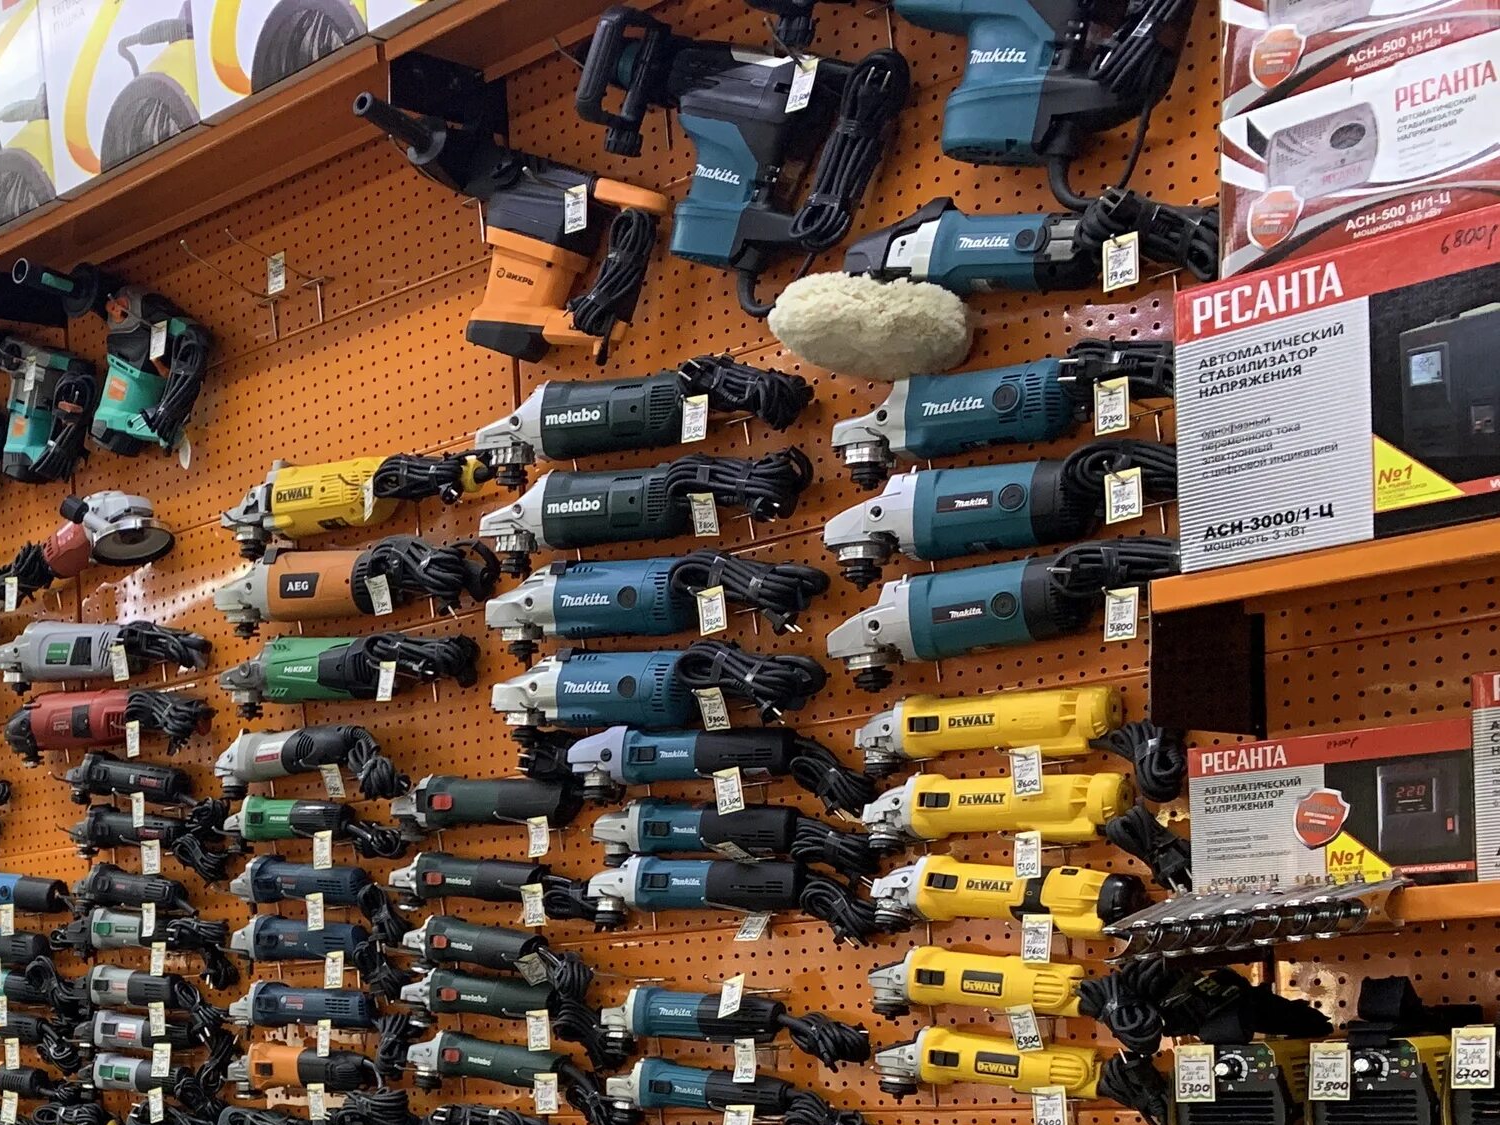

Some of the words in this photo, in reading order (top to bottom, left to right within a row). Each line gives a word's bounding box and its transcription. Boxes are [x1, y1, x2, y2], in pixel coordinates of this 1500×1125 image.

[970, 47, 1027, 65] Makita
[1394, 60, 1498, 113] РЕСАНТА
[694, 163, 741, 187] Makita
[1345, 204, 1406, 232] АСН-500
[959, 236, 1010, 249] Makita
[1192, 261, 1344, 335] РЕСАНТА
[1199, 321, 1345, 370] АВТОМАТИЧЕСКИЙ
[1199, 346, 1318, 384] СТАБИЛИЗАТОР
[1199, 364, 1302, 399] НАПРЯЖЕНИЯ
[922, 397, 985, 418] Makita
[545, 408, 601, 426] metabo
[547, 498, 601, 514] metabo
[954, 496, 989, 509] Makita
[1204, 502, 1335, 540] АСН-3000/1-Ц
[286, 580, 310, 592] AEG
[560, 593, 610, 607] Makita
[949, 606, 983, 619] Makita
[563, 680, 611, 694] Makita
[1202, 745, 1288, 775] РЕСАНТА
[1204, 776, 1302, 795] АВТОМАТИЧЕСКИЙ
[1395, 785, 1426, 799] 220
[1204, 790, 1285, 805] СТАБИЛИЗАТОР
[1204, 800, 1275, 815] НАПРЯЖЕНИЯ
[1329, 850, 1365, 867] №1
[1400, 861, 1469, 875] www.resanta.ru
[658, 1006, 693, 1018] Makita
